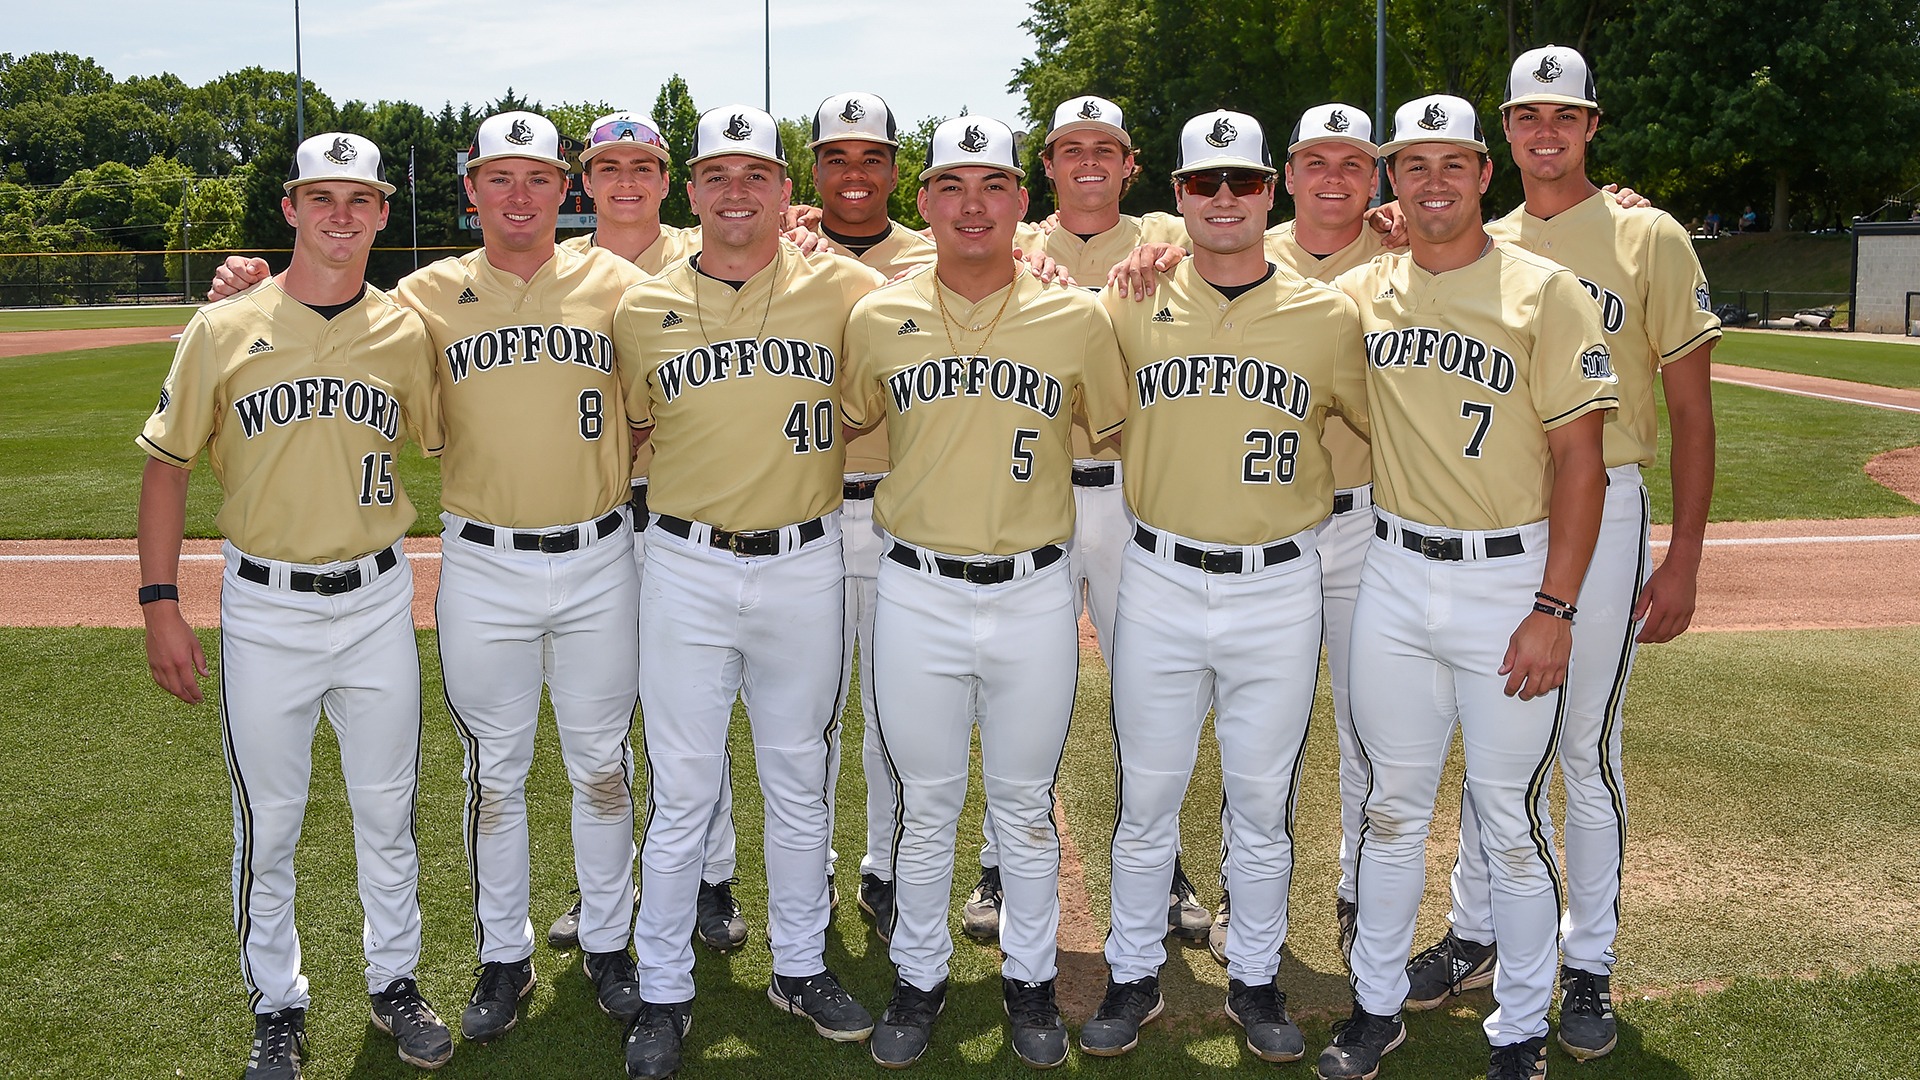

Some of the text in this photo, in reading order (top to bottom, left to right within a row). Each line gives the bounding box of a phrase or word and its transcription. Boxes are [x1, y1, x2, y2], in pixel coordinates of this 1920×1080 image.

[457, 296, 480, 305] adidas
[662, 317, 684, 329] adidas
[1152, 315, 1175, 323] adidas
[248, 345, 275, 355] adidas
[445, 324, 614, 385] WOFFORD
[898, 327, 921, 336] adidas
[657, 336, 836, 405] WOFFORD
[888, 355, 1063, 420] WOFFORD
[1135, 354, 1311, 421] WOFFORD
[233, 376, 400, 442] WOFFORD
[577, 388, 604, 441] 8
[782, 398, 835, 455] 40
[1460, 400, 1495, 459] 7
[359, 452, 396, 506] 15
[1010, 427, 1041, 482] 5
[1241, 428, 1301, 485] 28
